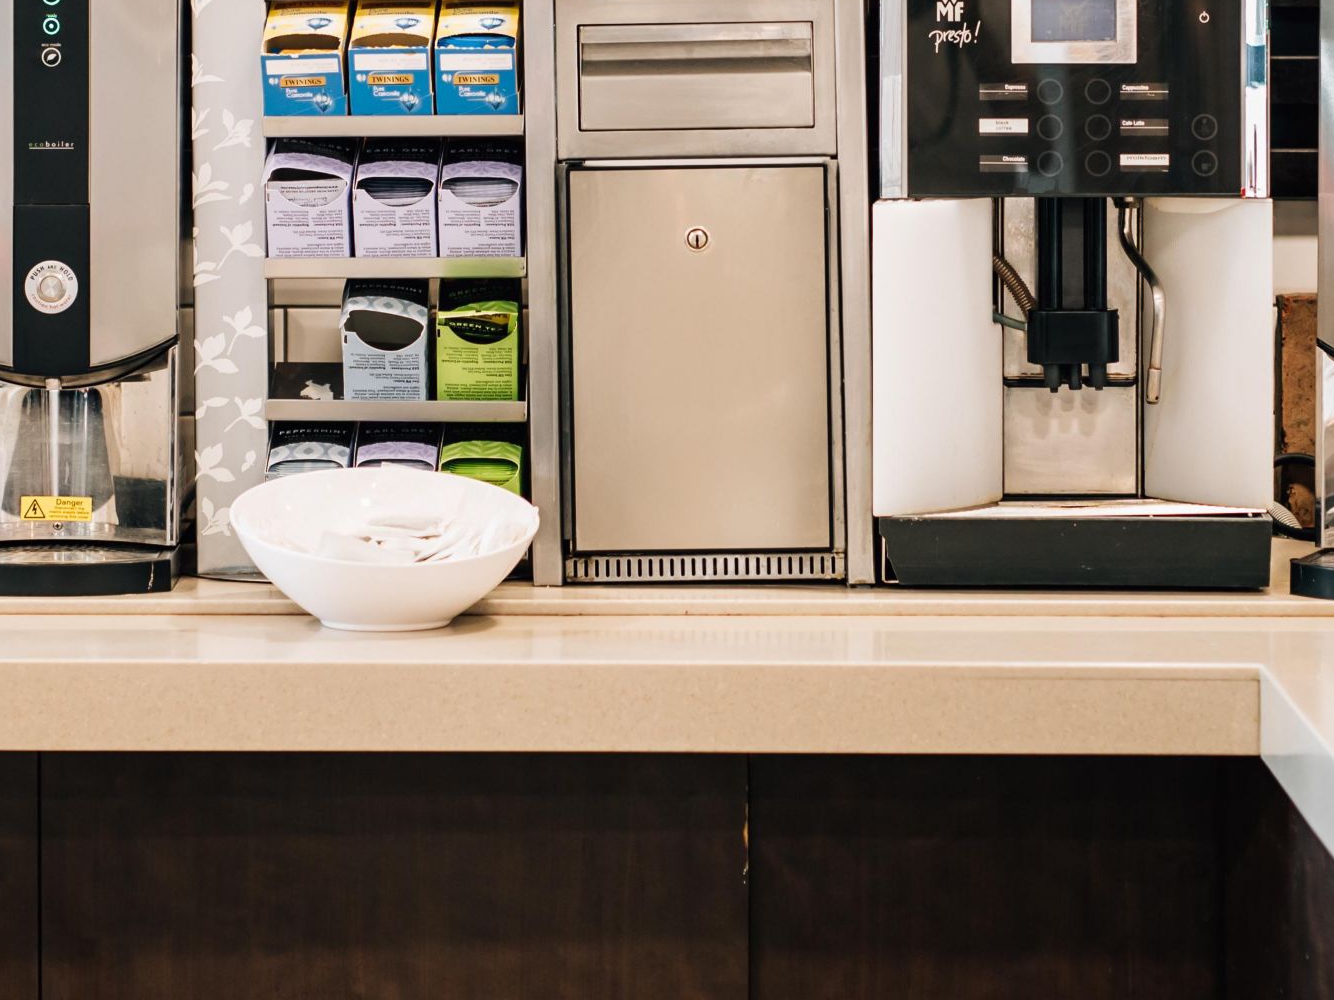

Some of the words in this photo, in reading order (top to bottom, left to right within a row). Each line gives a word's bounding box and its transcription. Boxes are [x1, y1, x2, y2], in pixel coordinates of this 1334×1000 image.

[285, 79, 322, 87] TWININGS
[372, 75, 409, 83] TWININGS
[458, 75, 495, 83] TWININGS
[28, 140, 74, 149] ecoboiler
[30, 265, 45, 281] PUSH
[59, 266, 74, 281] HOLD
[449, 321, 482, 329] GREEN
[279, 428, 348, 436] PEPPERMINT
[56, 498, 83, 507] Danger
